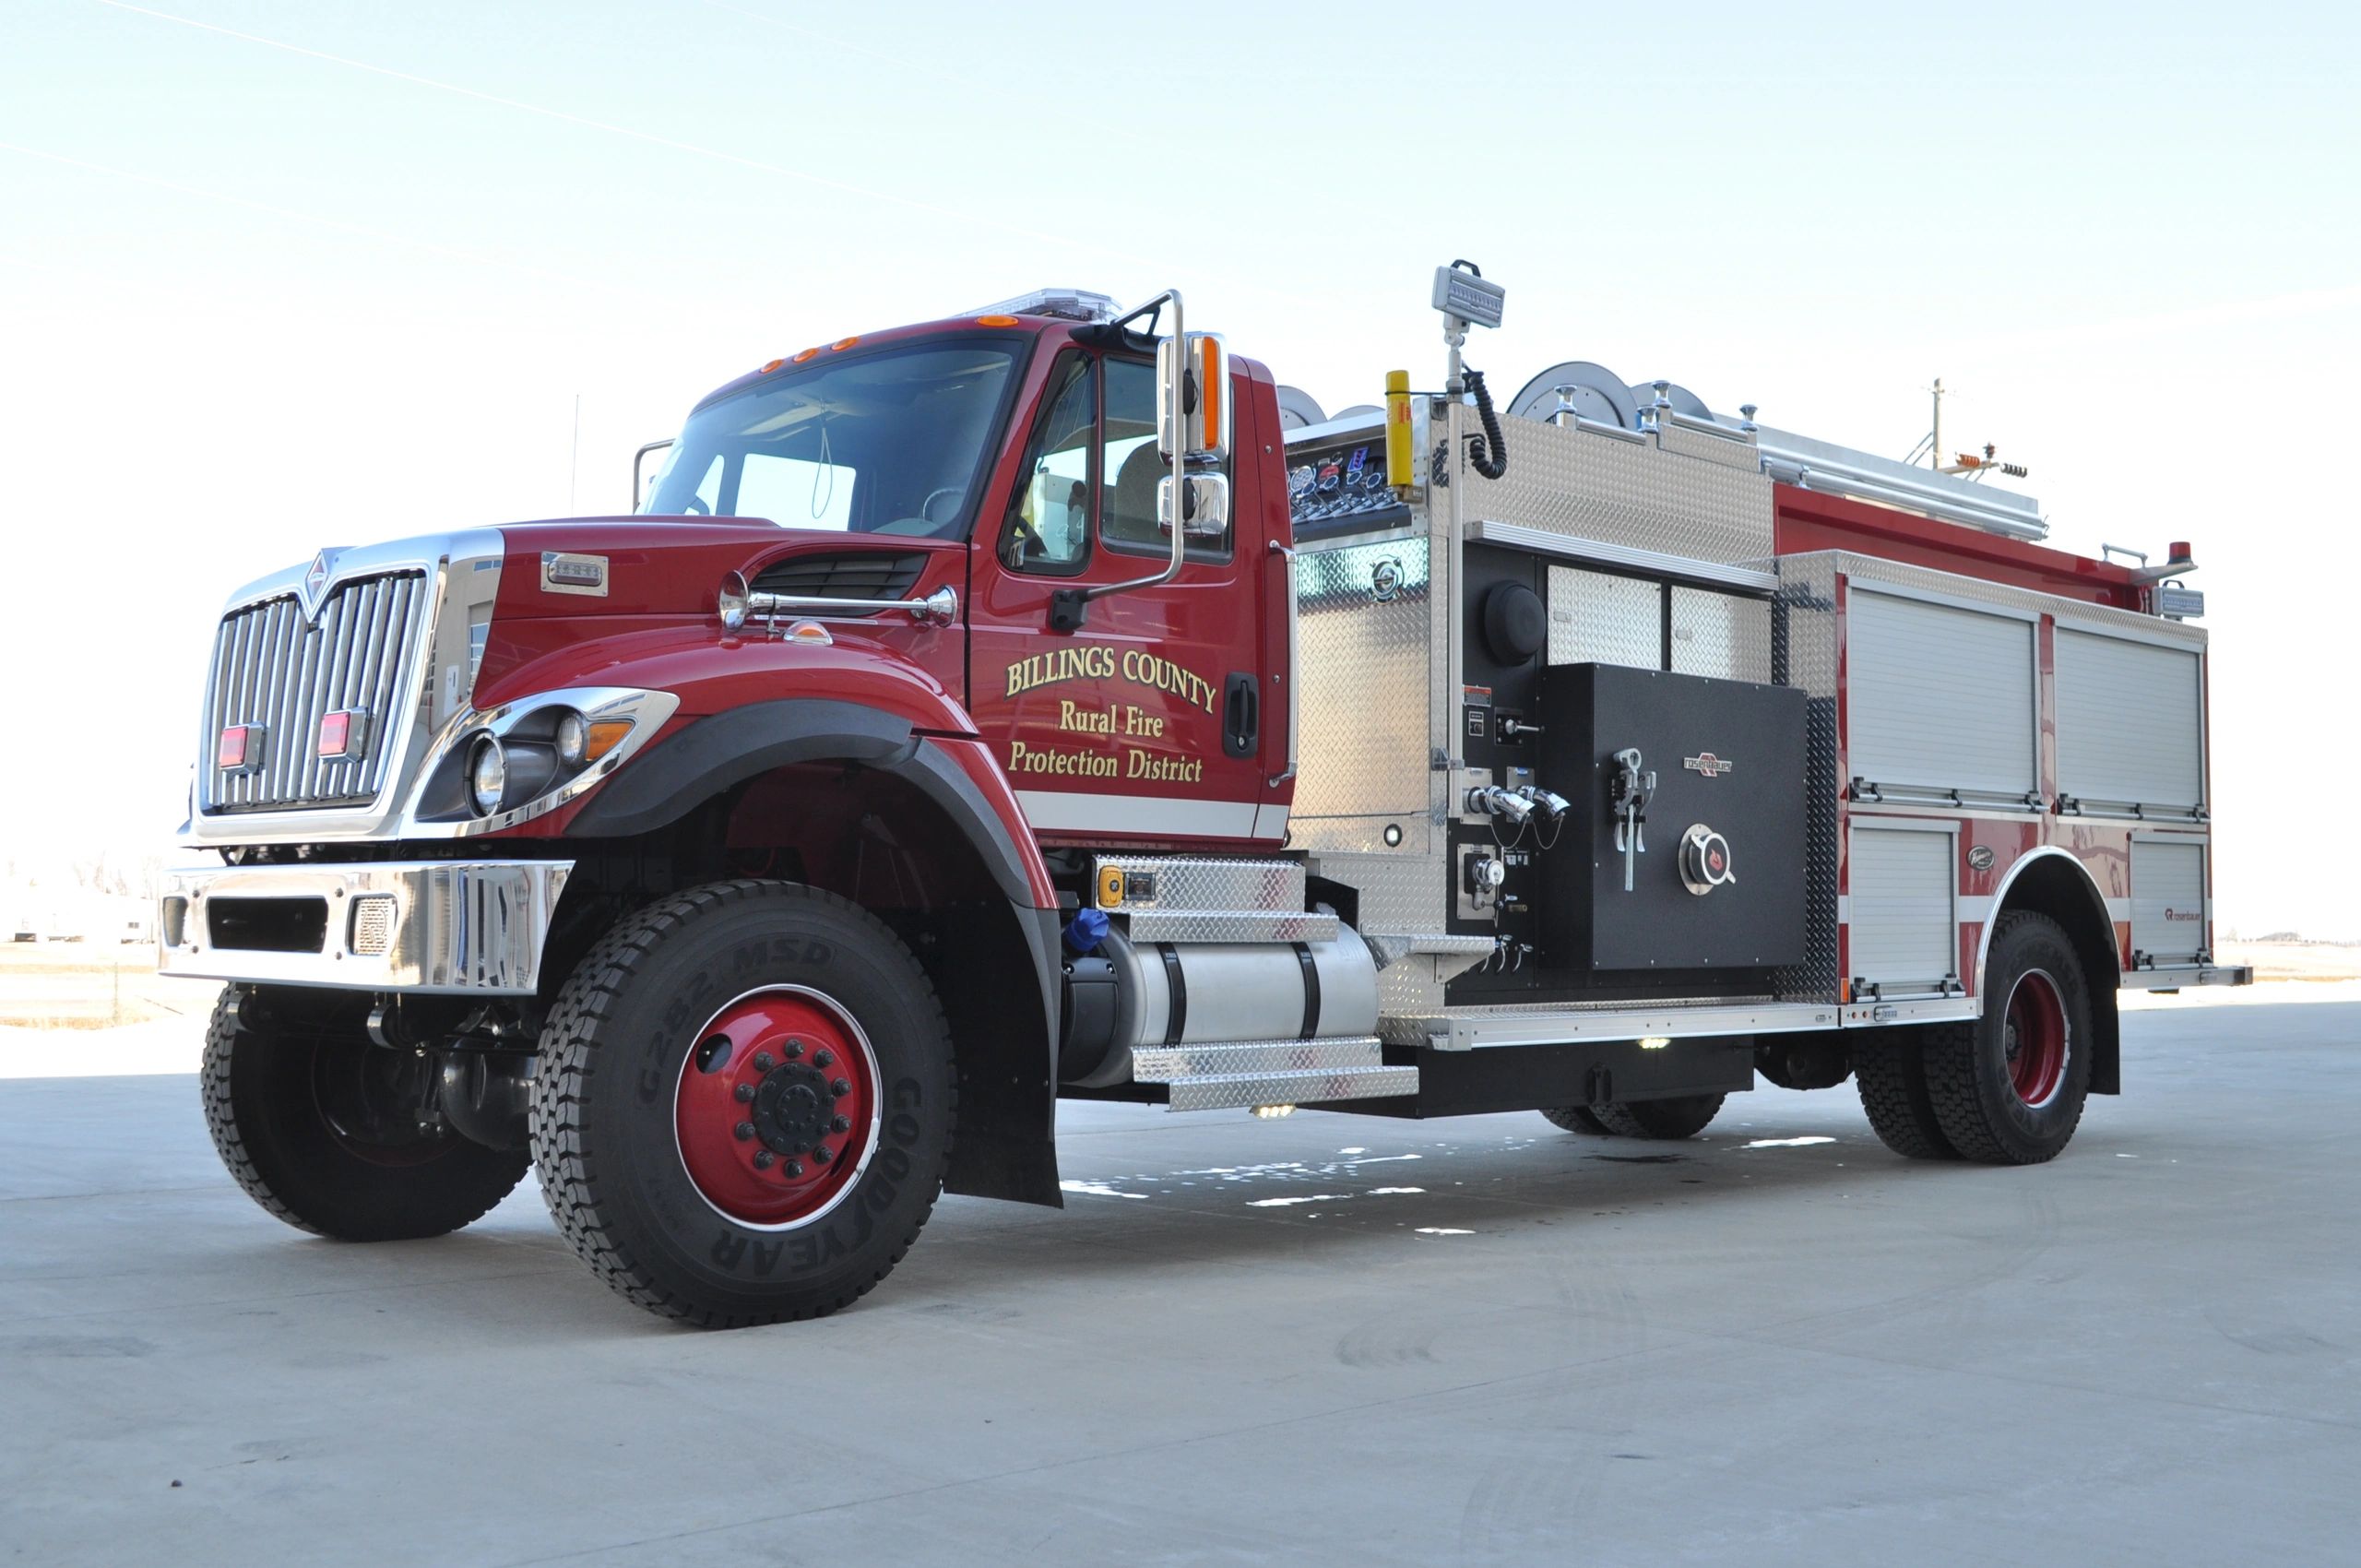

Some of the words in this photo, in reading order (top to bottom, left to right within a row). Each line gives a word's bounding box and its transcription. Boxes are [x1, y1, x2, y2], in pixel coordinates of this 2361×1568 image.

[1005, 646, 1116, 698] BILLINGS
[1121, 649, 1217, 715] COUNTY
[1059, 700, 1117, 735] Rural
[1124, 706, 1164, 738] Fire
[1008, 741, 1118, 778] Protection
[1125, 749, 1203, 783] District
[731, 937, 835, 970] MSD
[710, 1076, 922, 1277] GOODYEAR
